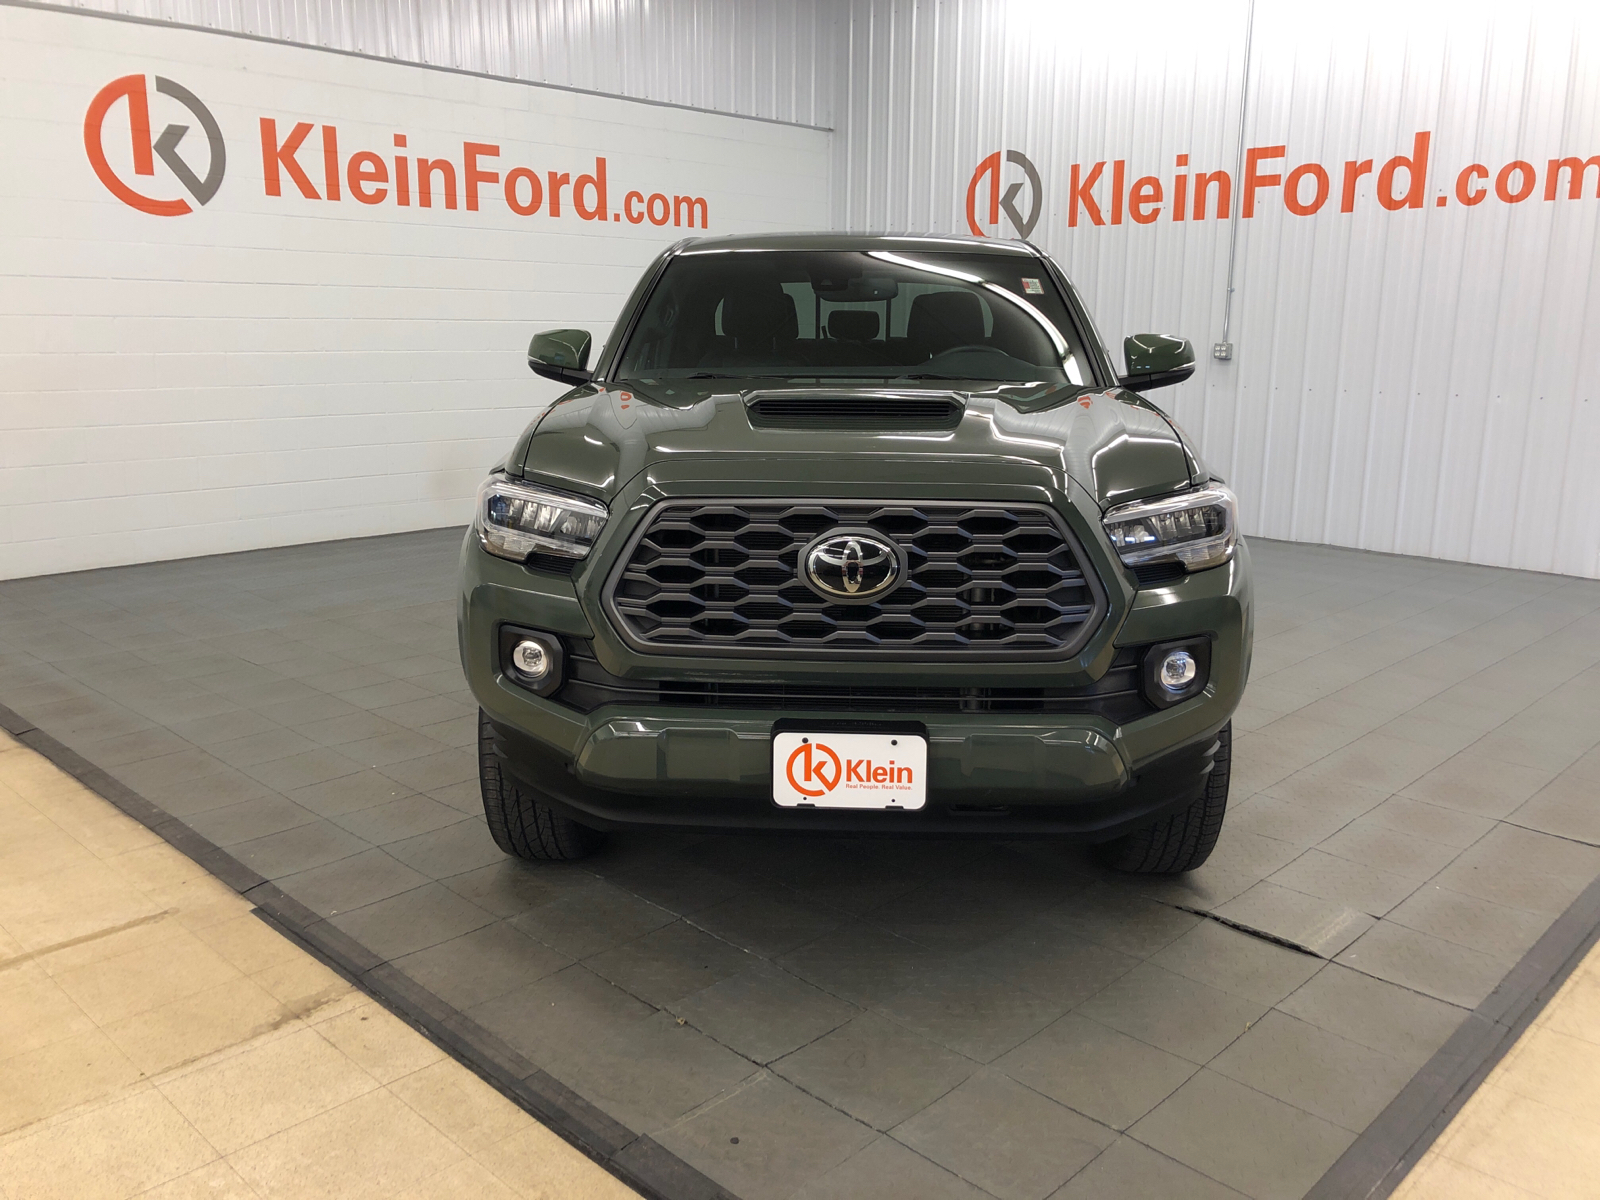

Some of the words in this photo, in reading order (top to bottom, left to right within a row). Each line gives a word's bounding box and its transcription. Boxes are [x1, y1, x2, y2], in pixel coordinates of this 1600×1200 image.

[260, 117, 708, 229] KleinFord.com
[1068, 131, 1600, 228] KleinFord.com
[846, 759, 913, 784] Klein
